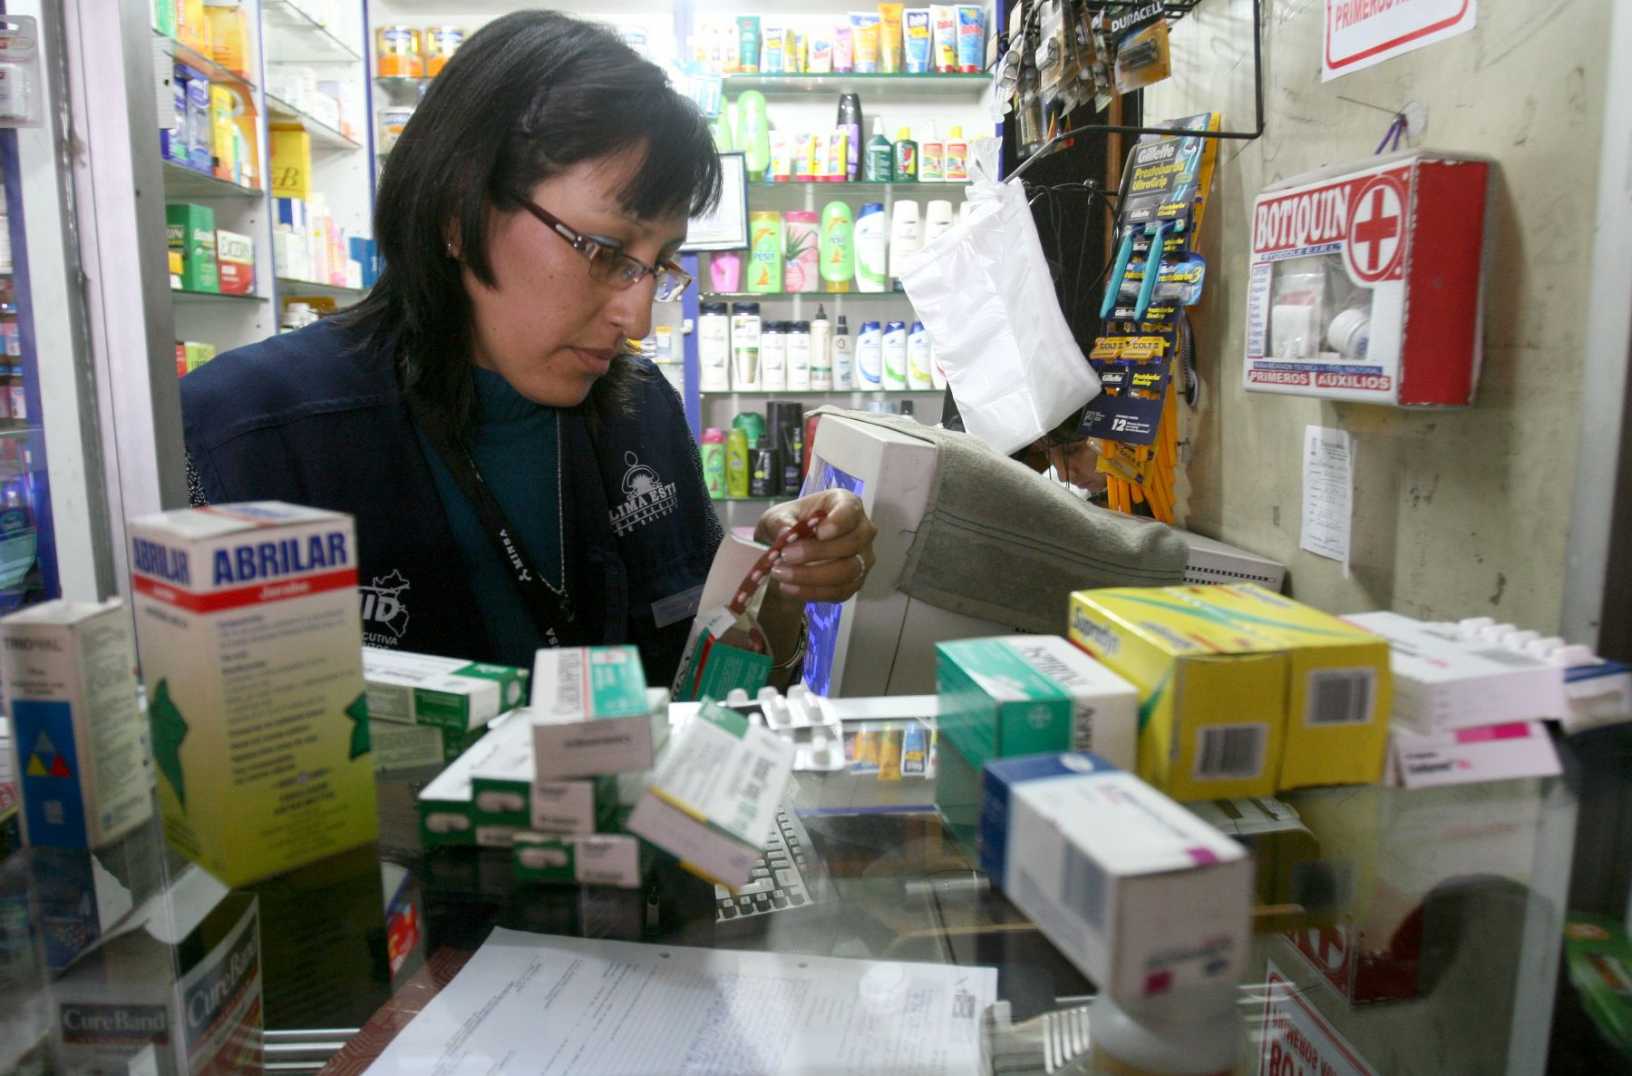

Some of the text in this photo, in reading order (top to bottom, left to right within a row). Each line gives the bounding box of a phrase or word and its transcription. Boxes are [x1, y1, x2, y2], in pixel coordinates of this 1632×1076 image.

[1111, 1, 1163, 32] DURACELL
[1255, 185, 1350, 250] BOTIQUIN
[1250, 371, 1391, 391] PRIMEROS AUXILIOS
[1111, 418, 1127, 432] 12
[608, 495, 649, 522] LIMA
[132, 536, 192, 586] ABRILAR
[212, 531, 348, 586] ABRILAR
[362, 631, 399, 646] CUTIVA
[62, 1006, 167, 1033] CureBand
